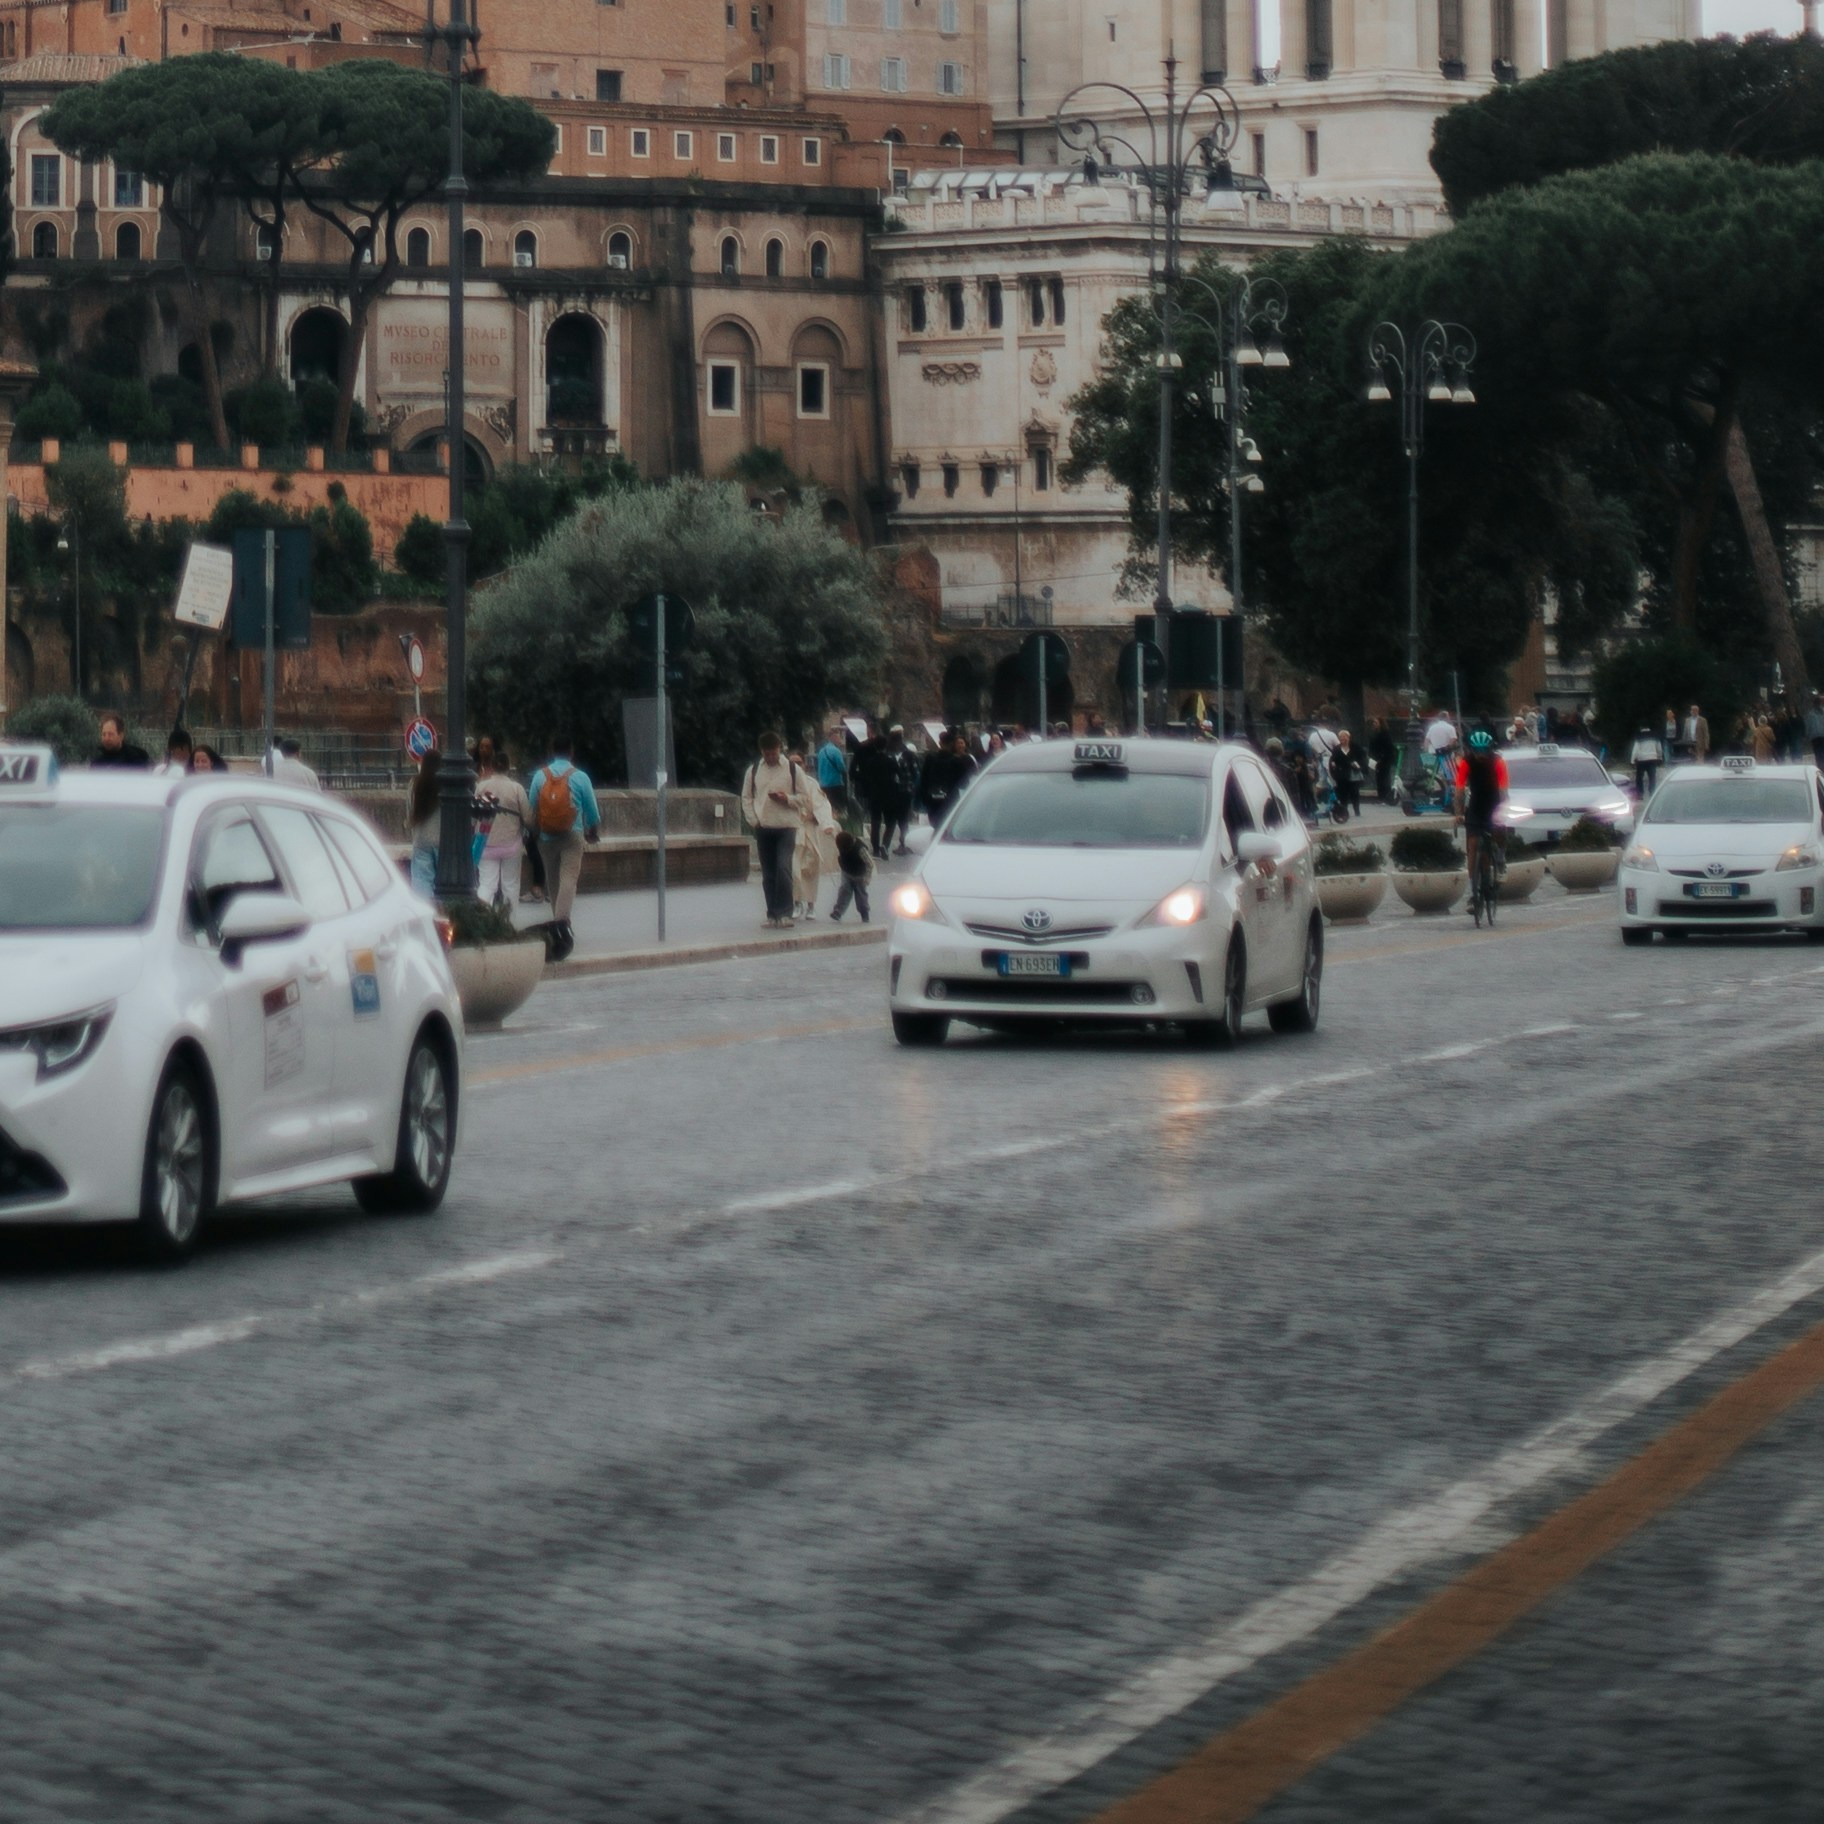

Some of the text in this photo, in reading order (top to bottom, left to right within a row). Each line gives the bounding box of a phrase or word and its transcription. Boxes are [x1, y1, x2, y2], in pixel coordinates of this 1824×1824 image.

[383, 325, 508, 340] MVSEO CETRALE
[390, 352, 501, 366] RISORGIENTO
[1078, 744, 1118, 758] TAXI
[1725, 759, 1751, 767] TAXI
